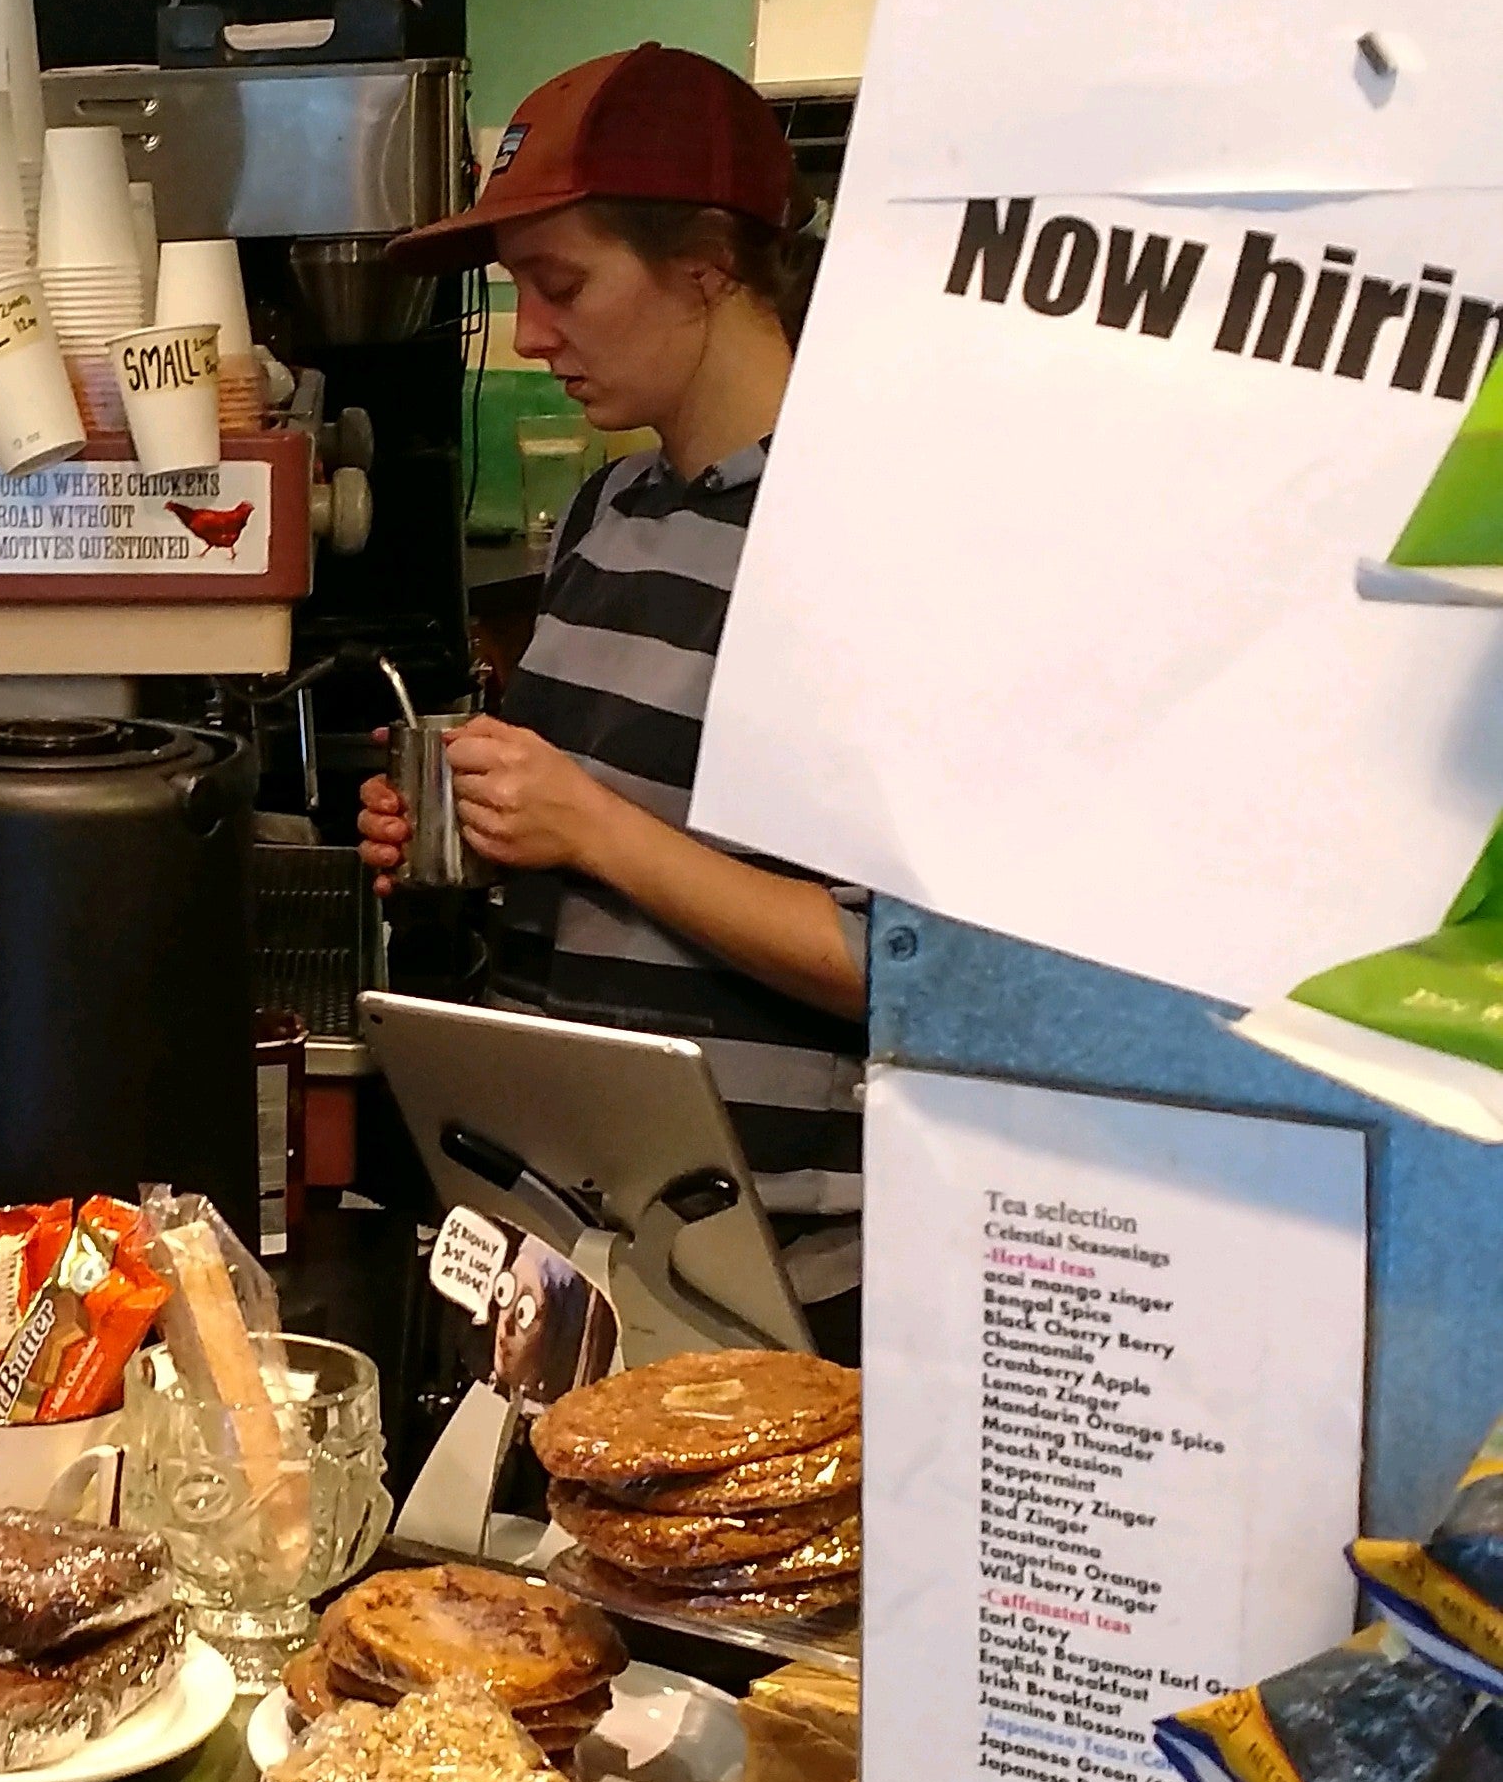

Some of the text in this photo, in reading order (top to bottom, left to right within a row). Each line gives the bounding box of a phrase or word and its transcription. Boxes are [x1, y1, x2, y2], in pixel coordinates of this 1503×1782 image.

[945, 197, 1208, 340] Now
[122, 339, 201, 393] SMALL
[55, 473, 123, 496] WHERE
[127, 473, 220, 496] CHICKENS
[49, 505, 135, 528] WITHOUT
[79, 536, 190, 560] QUESTIONED
[985, 1190, 1137, 1234] Tea selection
[985, 1221, 1170, 1268] Celestial Seasonings
[1060, 1260, 1095, 1278] teas
[984, 1289, 1111, 1323] Bengal Spice
[1031, 1278, 1101, 1302] mango
[1109, 1287, 1174, 1312] zinger
[983, 1331, 1094, 1364] Chamomile
[984, 1309, 1174, 1360] Black Cherry Berry
[982, 1372, 1120, 1411] Lemon Zinger
[983, 1351, 1151, 1396] Cranberry Apple
[982, 1394, 1225, 1454] Mandarin Orange Spice
[982, 1416, 1154, 1462] Morning Thunder
[981, 1457, 1096, 1493] Peppermint
[982, 1436, 1123, 1478] Peach Passion
[981, 1478, 1157, 1527] Raspberry Zinger
[981, 1499, 1089, 1534] Red Zinger
[980, 1520, 1101, 1559] Roastaroma
[979, 1540, 1162, 1595] Tangerine Orange
[979, 1561, 1157, 1614] Wild berry Zinger
[978, 1607, 1071, 1643] Earl Grey
[1097, 1615, 1131, 1634] teas
[978, 1627, 1047, 1656] Double
[1054, 1645, 1153, 1682] Bergamot
[1160, 1669, 1199, 1691] Earl
[978, 1648, 1149, 1702] English Breakfast
[978, 1669, 1123, 1717] Irish Breakfast
[978, 1691, 1145, 1743] Jasmine Blossom
[979, 1731, 1070, 1768] Japanese
